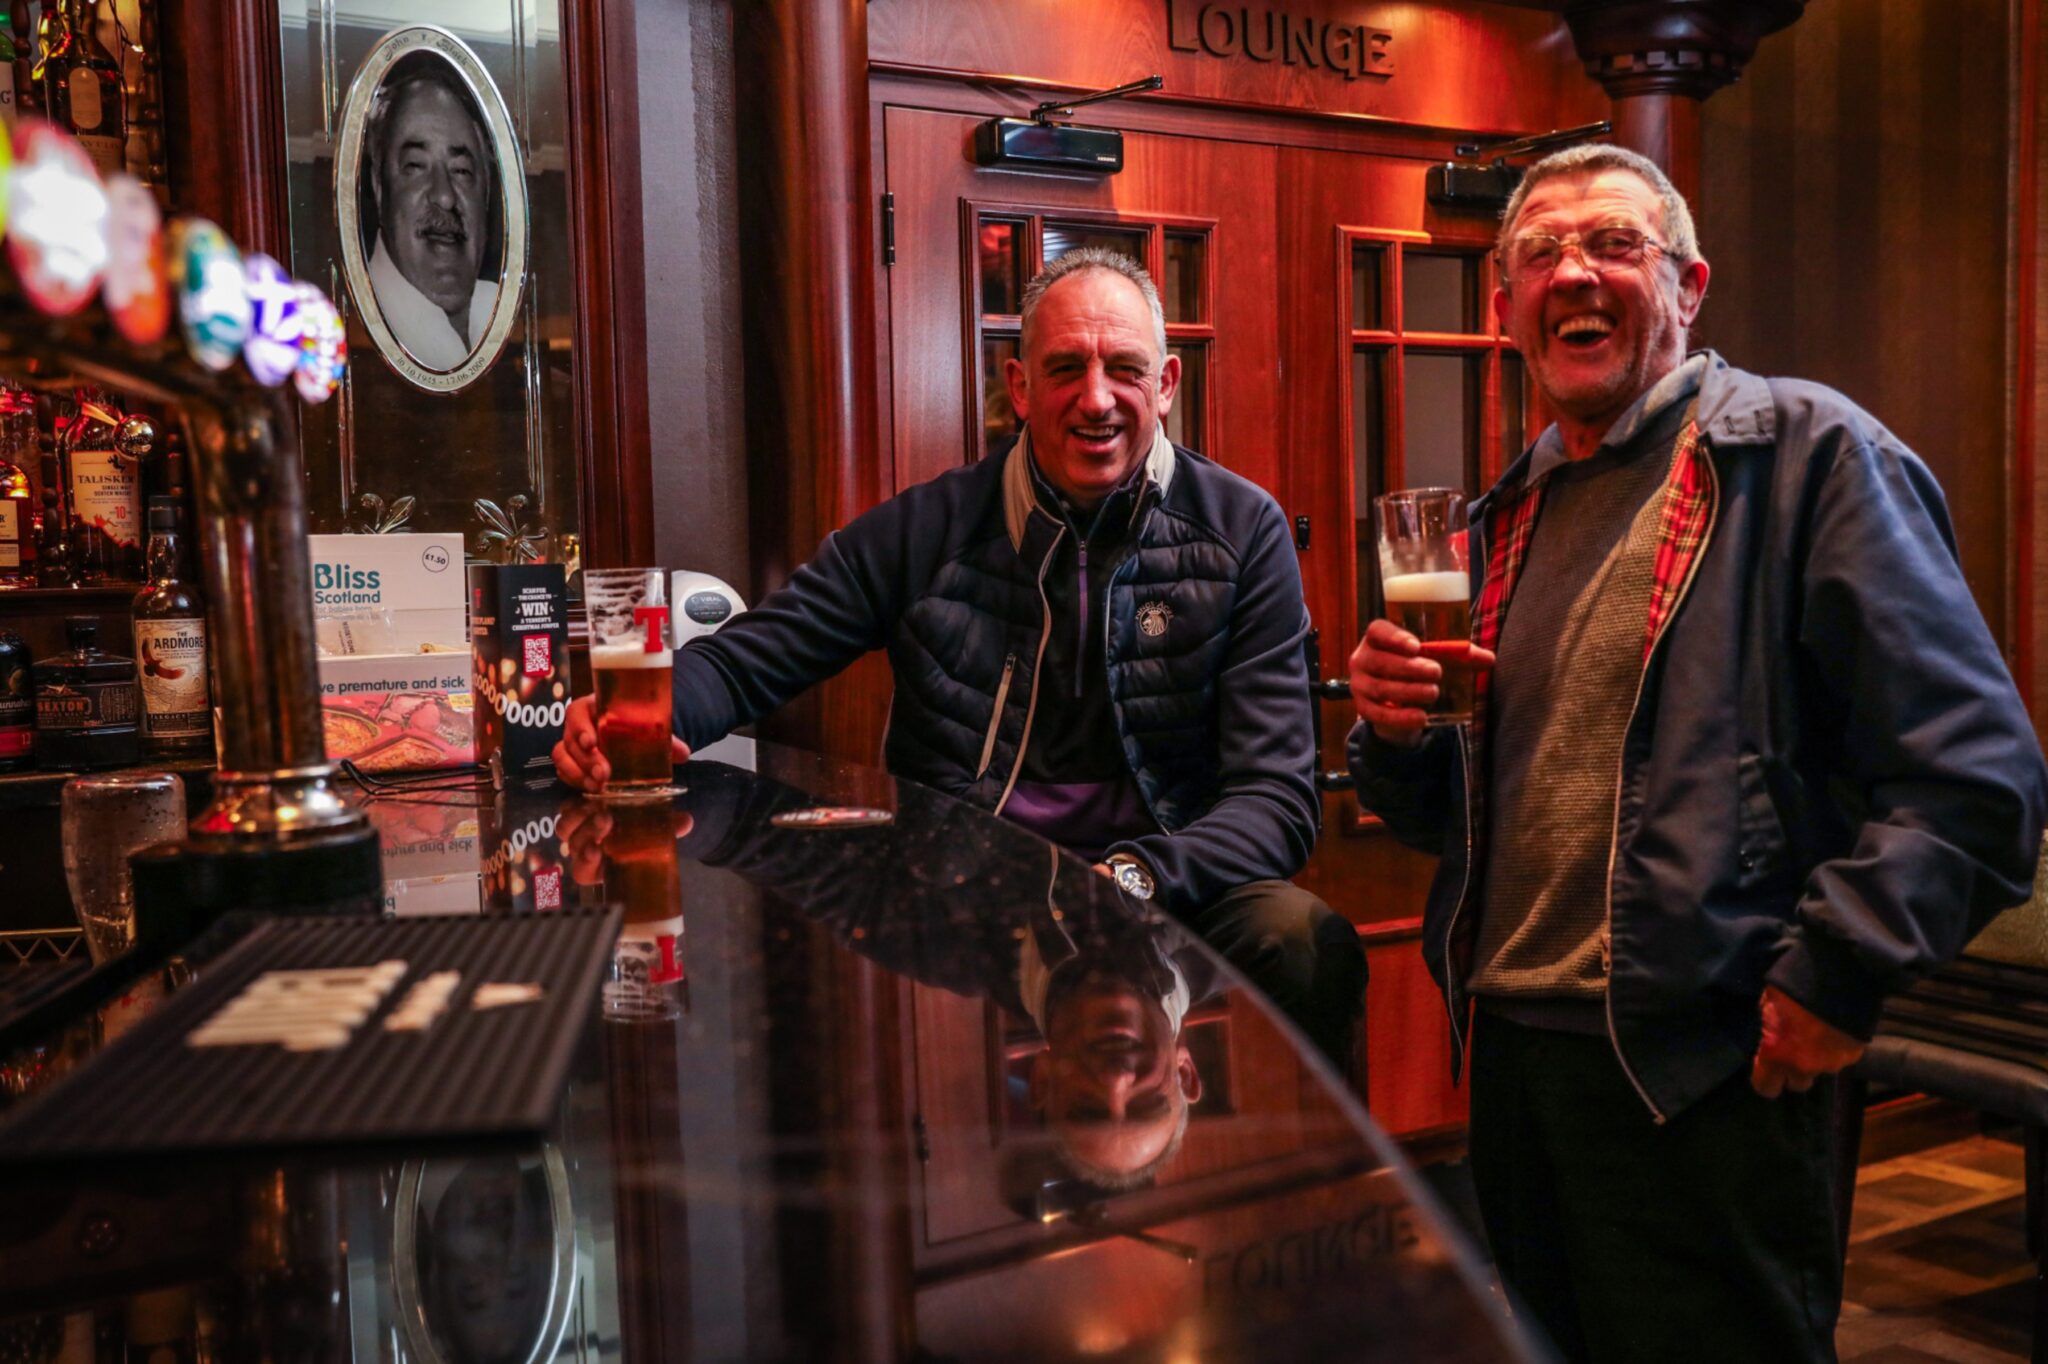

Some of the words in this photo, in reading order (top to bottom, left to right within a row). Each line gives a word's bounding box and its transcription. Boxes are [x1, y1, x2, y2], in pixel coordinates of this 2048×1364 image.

[1166, 0, 1394, 81] LOUNGE
[78, 475, 133, 485] TALISKER
[115, 506, 126, 519] 10
[425, 553, 446, 565] £1.50
[314, 564, 381, 590] Bliss
[314, 590, 381, 605] Scotland
[521, 602, 549, 617] WIN
[634, 606, 669, 653] T
[154, 636, 204, 650] ARDMORE
[338, 680, 408, 695] premature
[411, 677, 437, 689] and
[441, 676, 465, 689] sick
